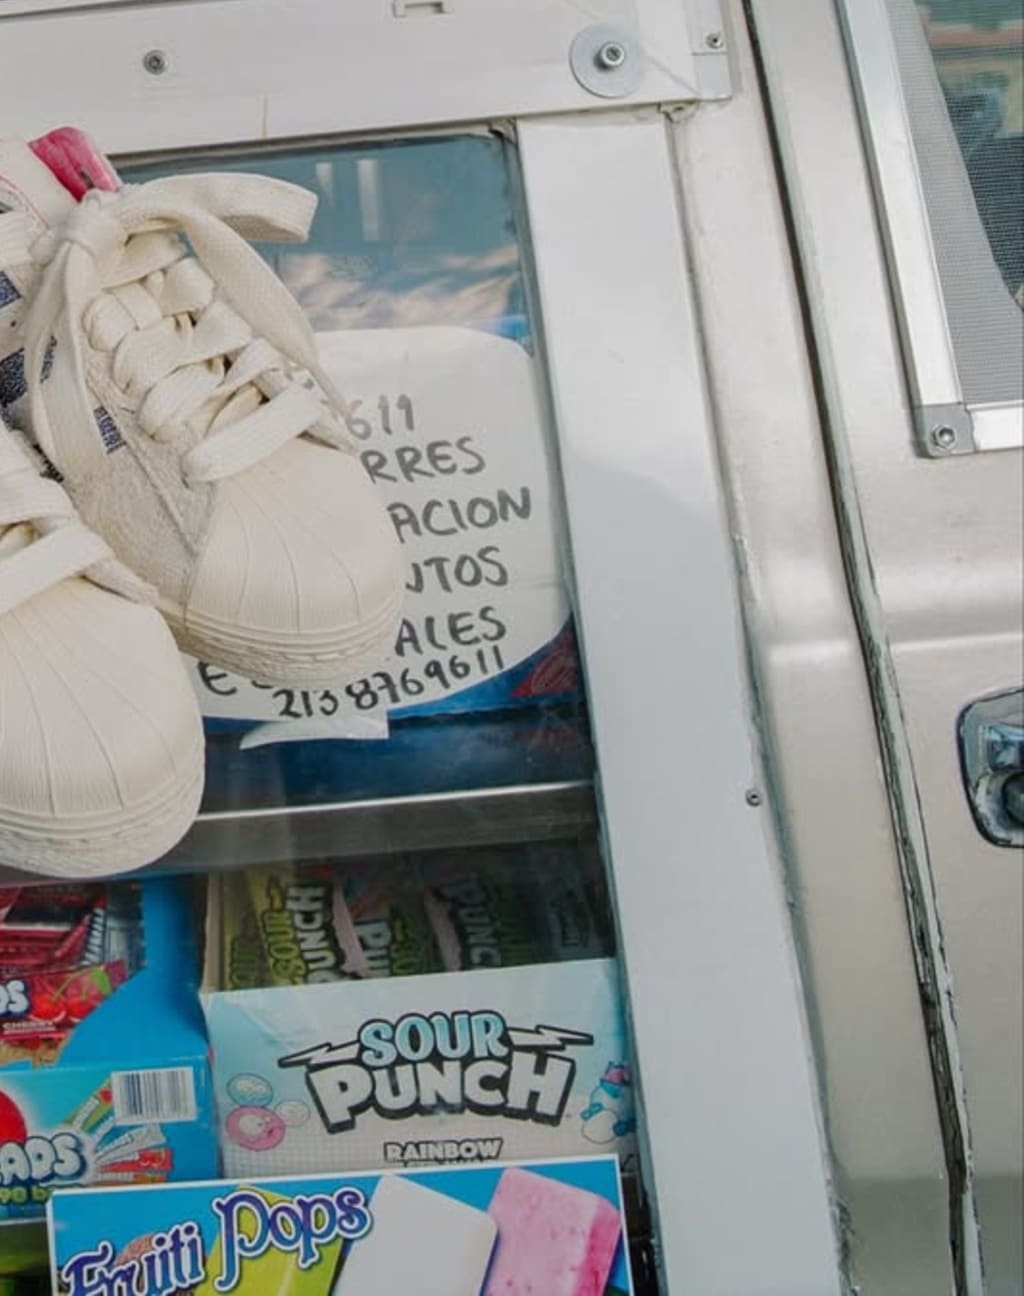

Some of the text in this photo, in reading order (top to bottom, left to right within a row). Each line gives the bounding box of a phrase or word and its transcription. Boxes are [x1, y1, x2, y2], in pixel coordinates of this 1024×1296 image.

[359, 436, 486, 484] RRES
[386, 486, 532, 543] ACION
[359, 1010, 507, 1067] SOUR
[307, 1050, 574, 1132] PUNCH
[384, 1137, 503, 1162] RAINBOW
[63, 1188, 369, 1296] Fruiti Pops
